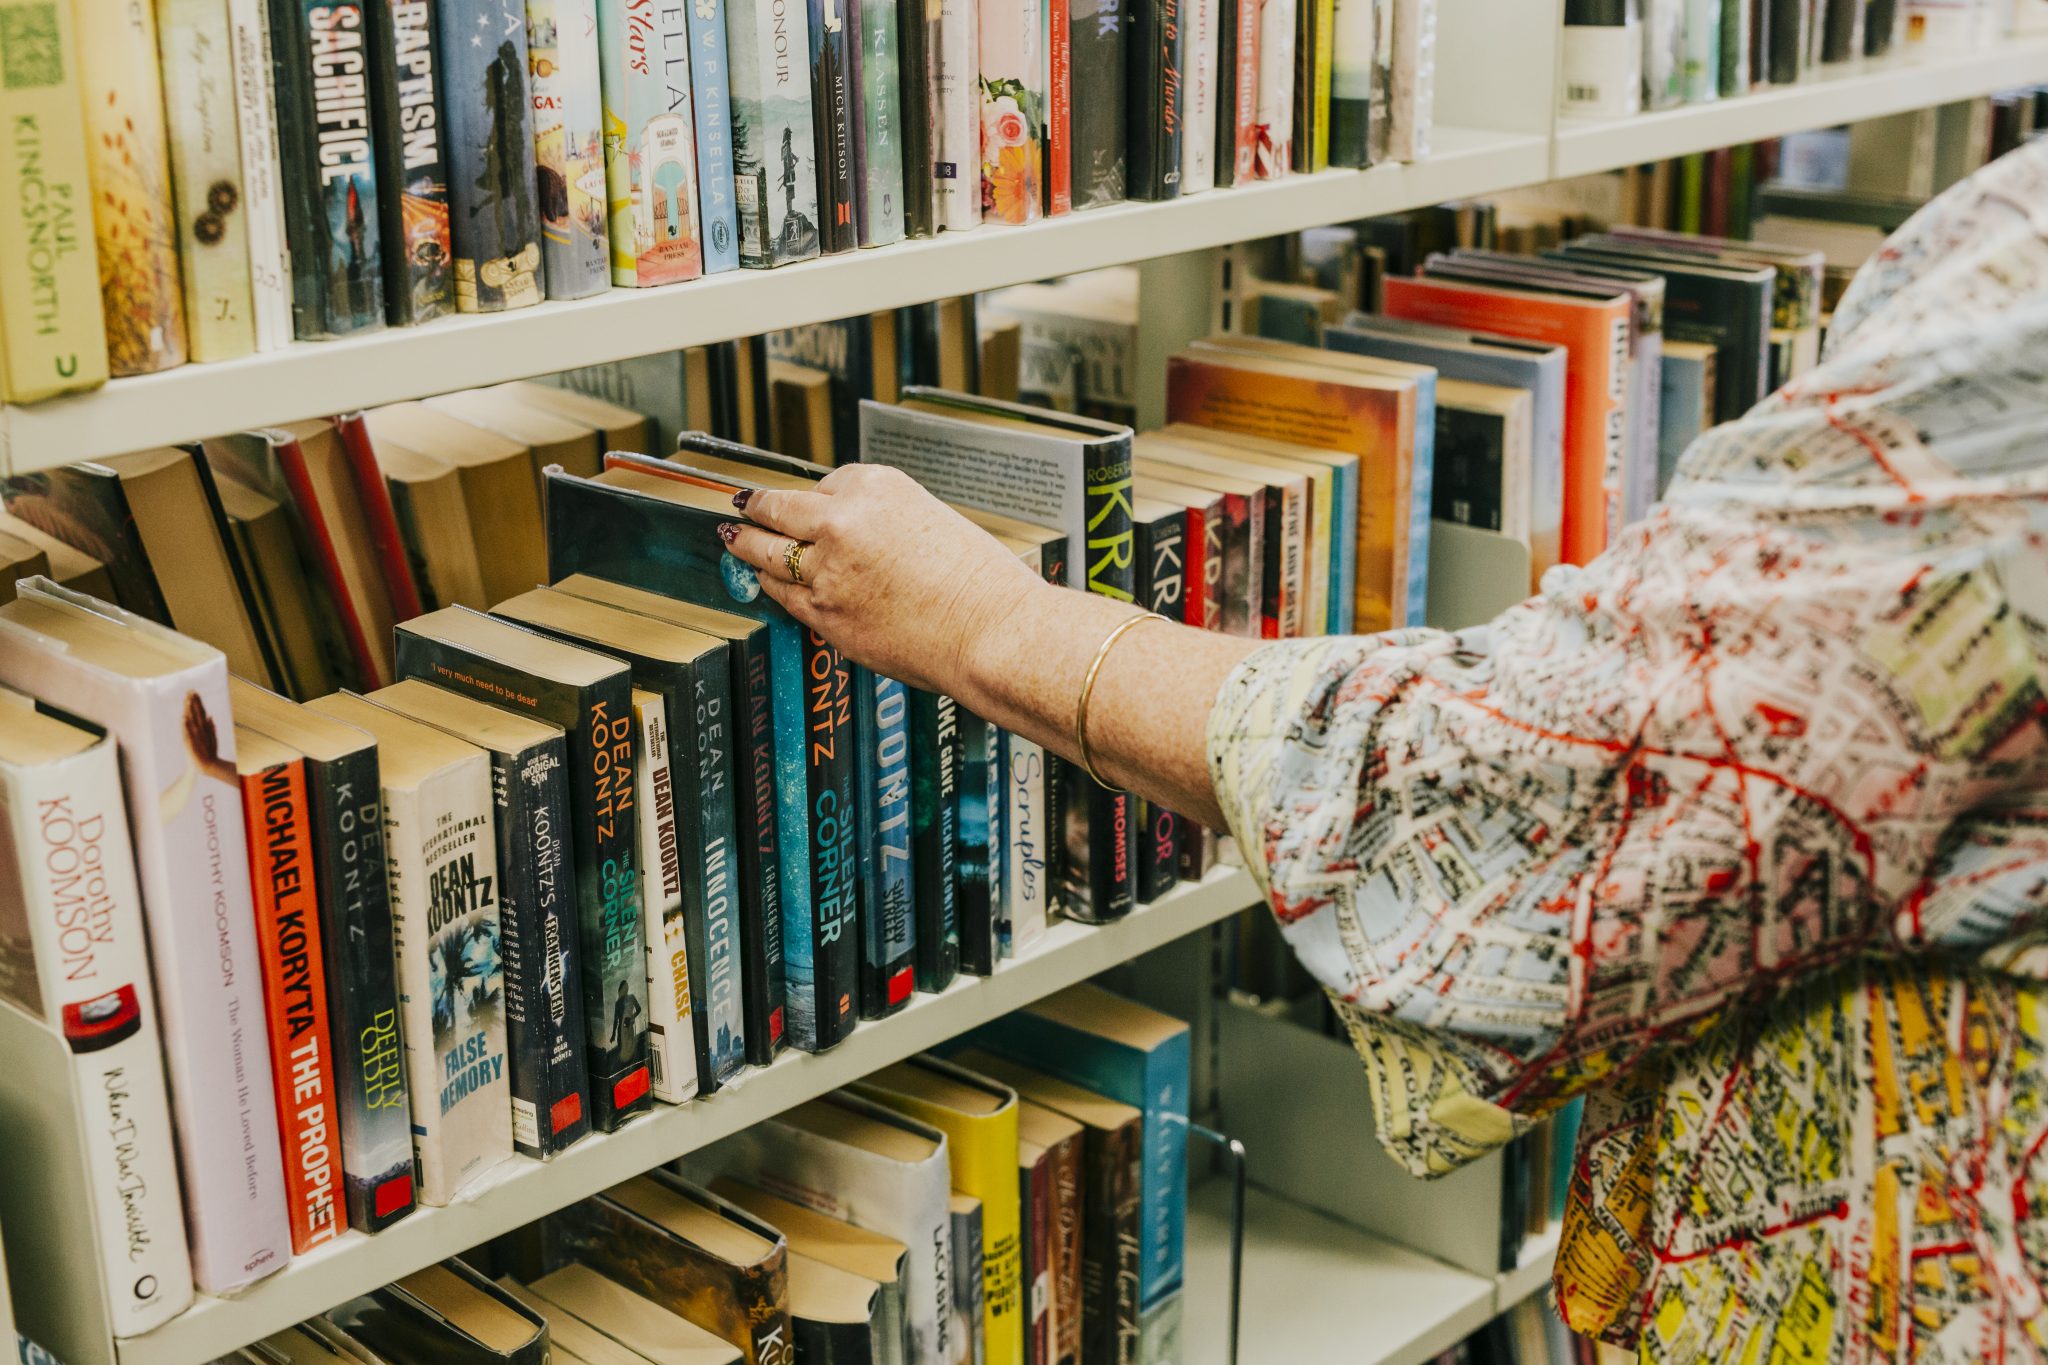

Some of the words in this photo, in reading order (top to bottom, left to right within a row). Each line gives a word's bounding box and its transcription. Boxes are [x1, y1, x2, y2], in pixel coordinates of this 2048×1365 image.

[624, 0, 655, 76] Stars
[703, 29, 715, 52] W.
[1052, 34, 1061, 56] They
[1166, 22, 1179, 40] to
[309, 5, 371, 187] SACRIFICE
[391, 0, 439, 171] BAPTISM
[705, 60, 717, 79] P.
[834, 75, 845, 119] MICK
[873, 28, 889, 148] KLASSEN
[1053, 58, 1061, 83] Move
[1164, 45, 1184, 137] Murder
[706, 87, 724, 206] KINSELLA
[837, 122, 848, 182] KITSON
[14, 113, 60, 336] KINGSNORTH
[51, 183, 78, 260] PAUL
[658, 243, 689, 255] BANTAM
[664, 251, 687, 261] PRESS
[437, 666, 453, 678] very
[454, 671, 475, 685] much
[475, 679, 495, 693] need
[495, 686, 504, 695] to
[505, 687, 515, 699] be
[810, 628, 835, 767] OONTZ
[521, 756, 561, 782] PRODIGAL
[531, 771, 549, 787] SON
[591, 700, 614, 844] KOONTZ
[611, 715, 633, 812] DEAN
[694, 679, 712, 822] KOONTZ
[706, 696, 725, 794] DEAN
[940, 744, 954, 798] GRAVE
[437, 811, 453, 827] THE
[652, 766, 674, 821] DEAN
[753, 741, 774, 854] KOONTZ
[1012, 751, 1046, 902] Scruples
[261, 760, 302, 911] MICHAEL
[336, 782, 365, 942] KOONTZ
[425, 831, 477, 867] BESTSELLER
[534, 805, 556, 909] KOONTZ'S
[551, 838, 562, 868] DEAN
[657, 819, 680, 899] KOONTZ
[816, 789, 843, 947] CORNER
[839, 803, 857, 923] SILENT
[941, 806, 954, 872] MICHAEL
[1114, 794, 1127, 883] PROMISES
[1156, 811, 1174, 865] OR
[37, 795, 97, 982] KOOMSON
[77, 814, 117, 944] Dorothy
[202, 793, 223, 886] DOROTHY
[213, 889, 235, 988] KOOMSON
[426, 876, 494, 937] KOONTZ
[430, 852, 479, 904] DEAN
[602, 858, 621, 970] CORNER
[619, 869, 638, 955] SILENT
[764, 863, 781, 966] FRANKENSTEIN
[704, 836, 732, 1021] INNOCENCE
[227, 999, 238, 1027] The
[276, 908, 317, 1042] KORYTA
[671, 949, 692, 1023] CHASE
[103, 1066, 130, 1122] When
[230, 1027, 246, 1085] Woman
[289, 1035, 322, 1106] THE
[360, 1025, 386, 1111] ODD
[374, 1006, 402, 1113] DEEPLY
[439, 1053, 504, 1119] MEMORY
[444, 1031, 488, 1082] FALSE
[236, 1085, 247, 1109] He
[239, 1108, 252, 1153] Loved
[114, 1141, 137, 1182] Was
[244, 1153, 258, 1201] Before
[297, 1102, 338, 1246] PROPHET
[117, 1176, 154, 1264] Invisible
[244, 1250, 276, 1273] sphere
